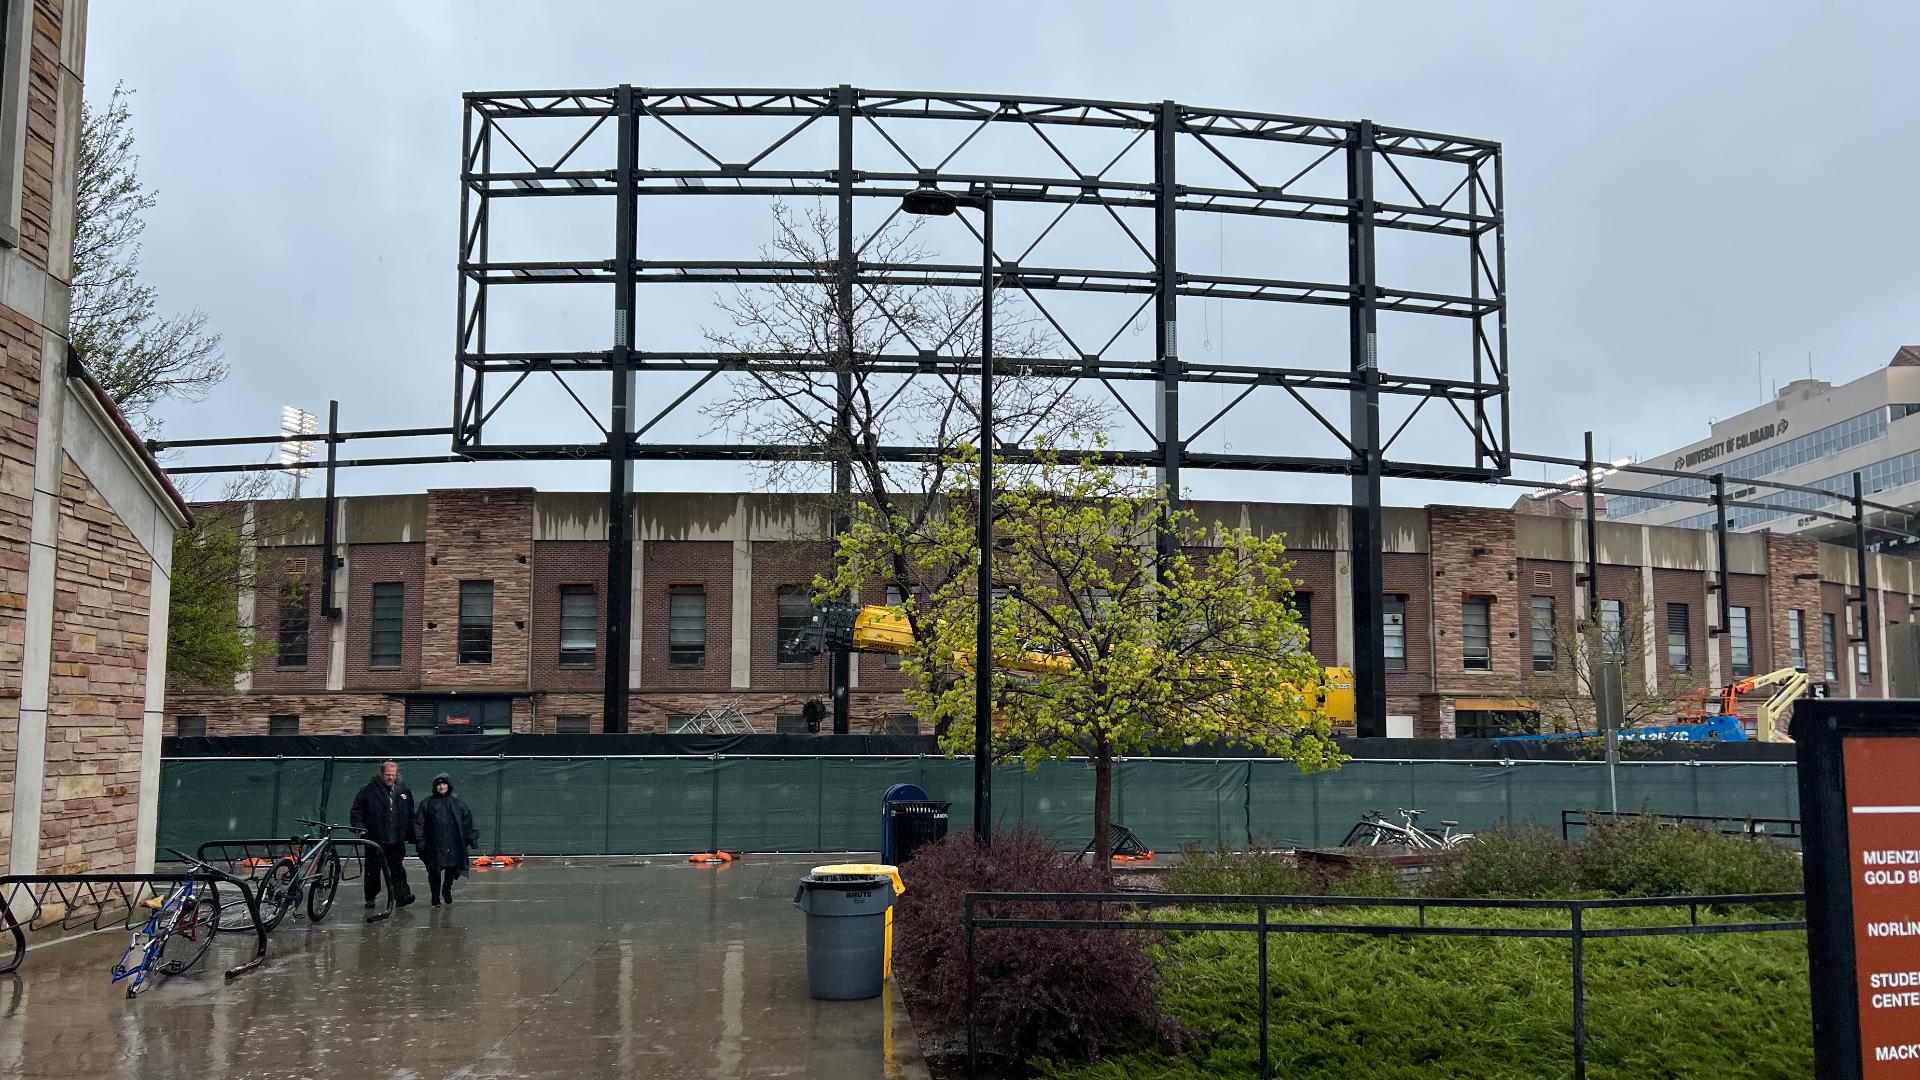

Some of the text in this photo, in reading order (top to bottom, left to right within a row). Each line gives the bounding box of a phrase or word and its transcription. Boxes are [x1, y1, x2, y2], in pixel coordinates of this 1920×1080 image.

[1686, 424, 1775, 467] UNIVERSITY OF COLORADO
[1863, 849, 1920, 865] MUENZI
[1864, 869, 1920, 885] GOLD B
[846, 890, 872, 898] BRUTE
[1867, 921, 1920, 937] NORLIN
